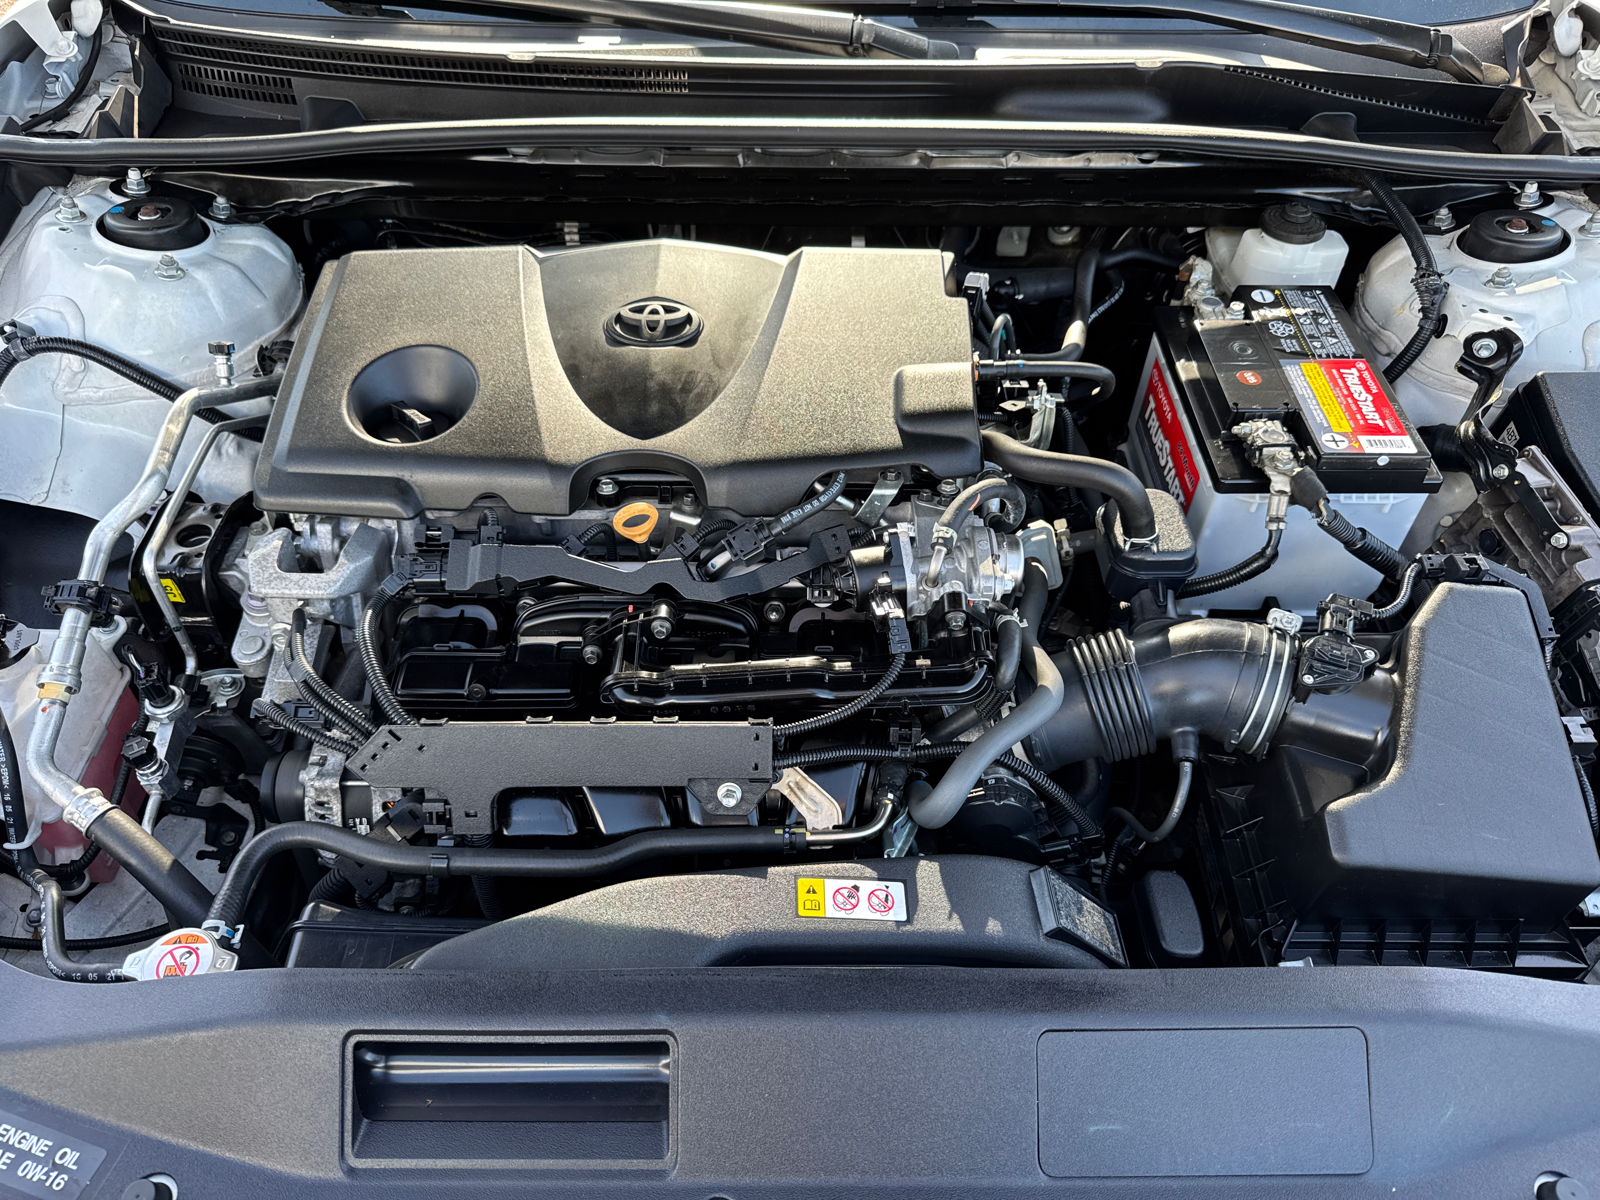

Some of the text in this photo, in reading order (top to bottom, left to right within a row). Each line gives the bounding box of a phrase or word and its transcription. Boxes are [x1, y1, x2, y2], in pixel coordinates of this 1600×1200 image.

[1340, 367, 1385, 428] TRUESTART
[1360, 370, 1379, 393] TOYOTA
[1156, 381, 1172, 424] TOYOTA
[87, 972, 98, 981] 05
[0, 1123, 81, 1171] ENGINE OIL
[17, 1160, 69, 1191] 0W-16
